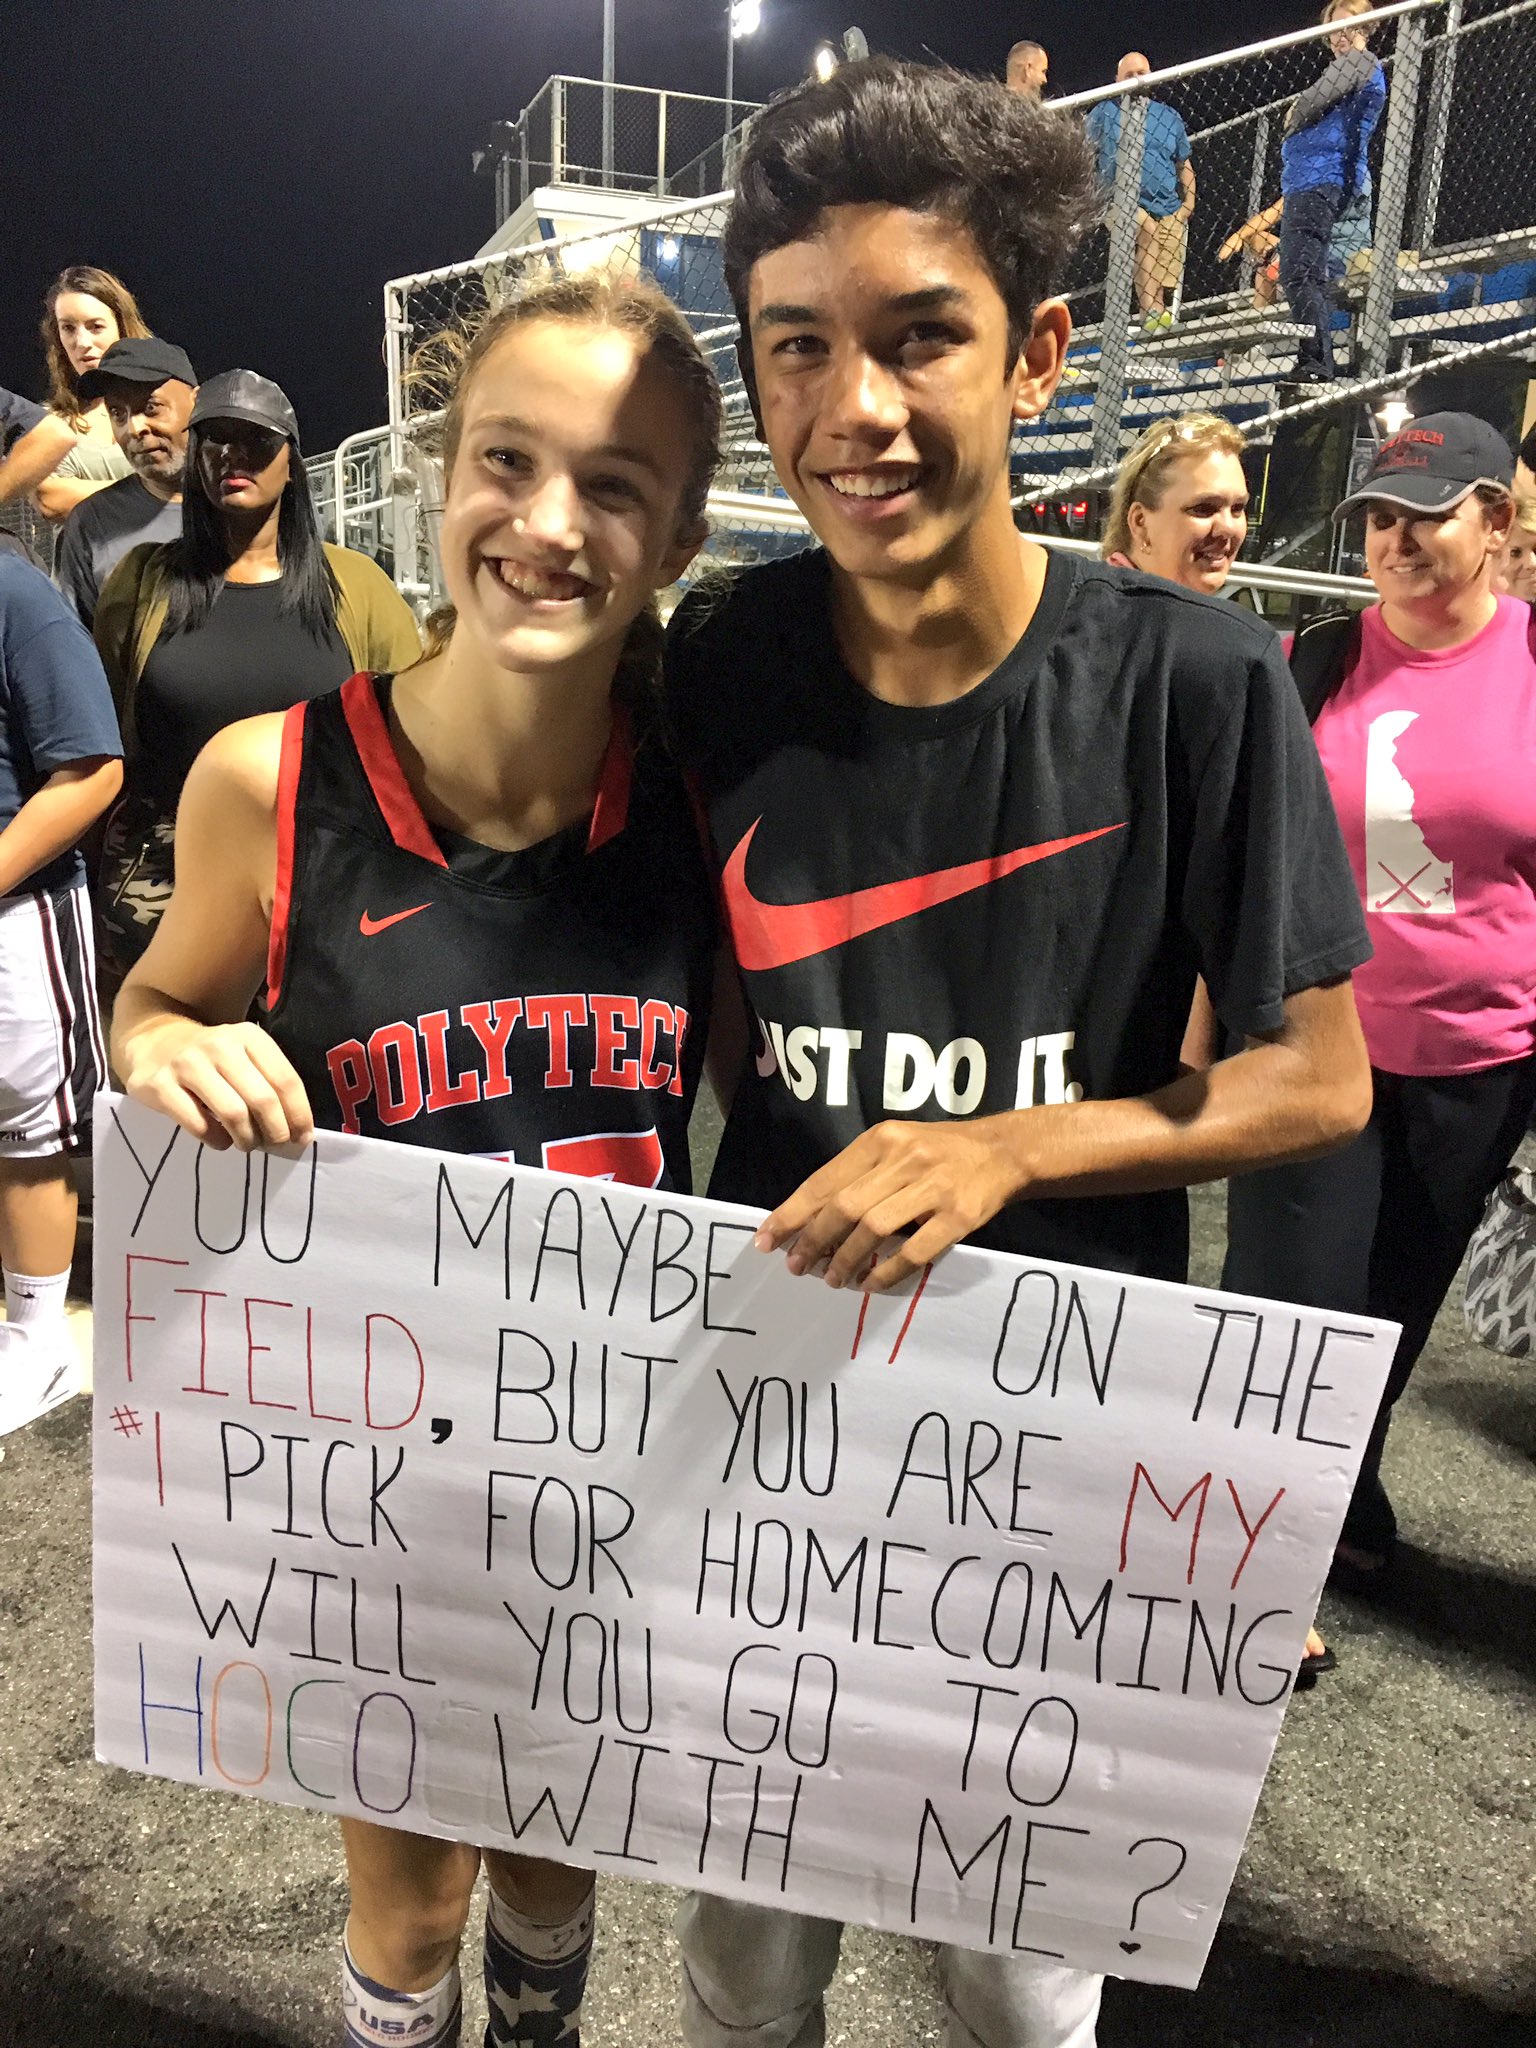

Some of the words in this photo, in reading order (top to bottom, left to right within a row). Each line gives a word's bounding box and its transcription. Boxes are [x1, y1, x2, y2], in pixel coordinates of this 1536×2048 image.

[882, 1031, 987, 1115] DO
[110, 1106, 318, 1264] YOU
[433, 1162, 759, 1336] MAYBE
[992, 1270, 1126, 1406] ON
[1192, 1303, 1374, 1449] THE
[109, 1404, 166, 1507] #1
[220, 1420, 408, 1553] PICK
[486, 1470, 635, 1599] FOR
[696, 1507, 1294, 1706] HOMECOMING
[493, 1327, 679, 1456] BUT
[716, 1367, 838, 1497] YOU
[886, 1411, 1063, 1537] ARE
[1118, 1460, 1287, 1590] MY
[138, 1641, 417, 1814] HOCO
[494, 1713, 803, 1893] WITH
[171, 1542, 437, 1686] WILL
[502, 1600, 653, 1734] YOU
[723, 1643, 838, 1768] GO
[946, 1679, 1079, 1807] TO
[359, 2007, 434, 2035] USA
